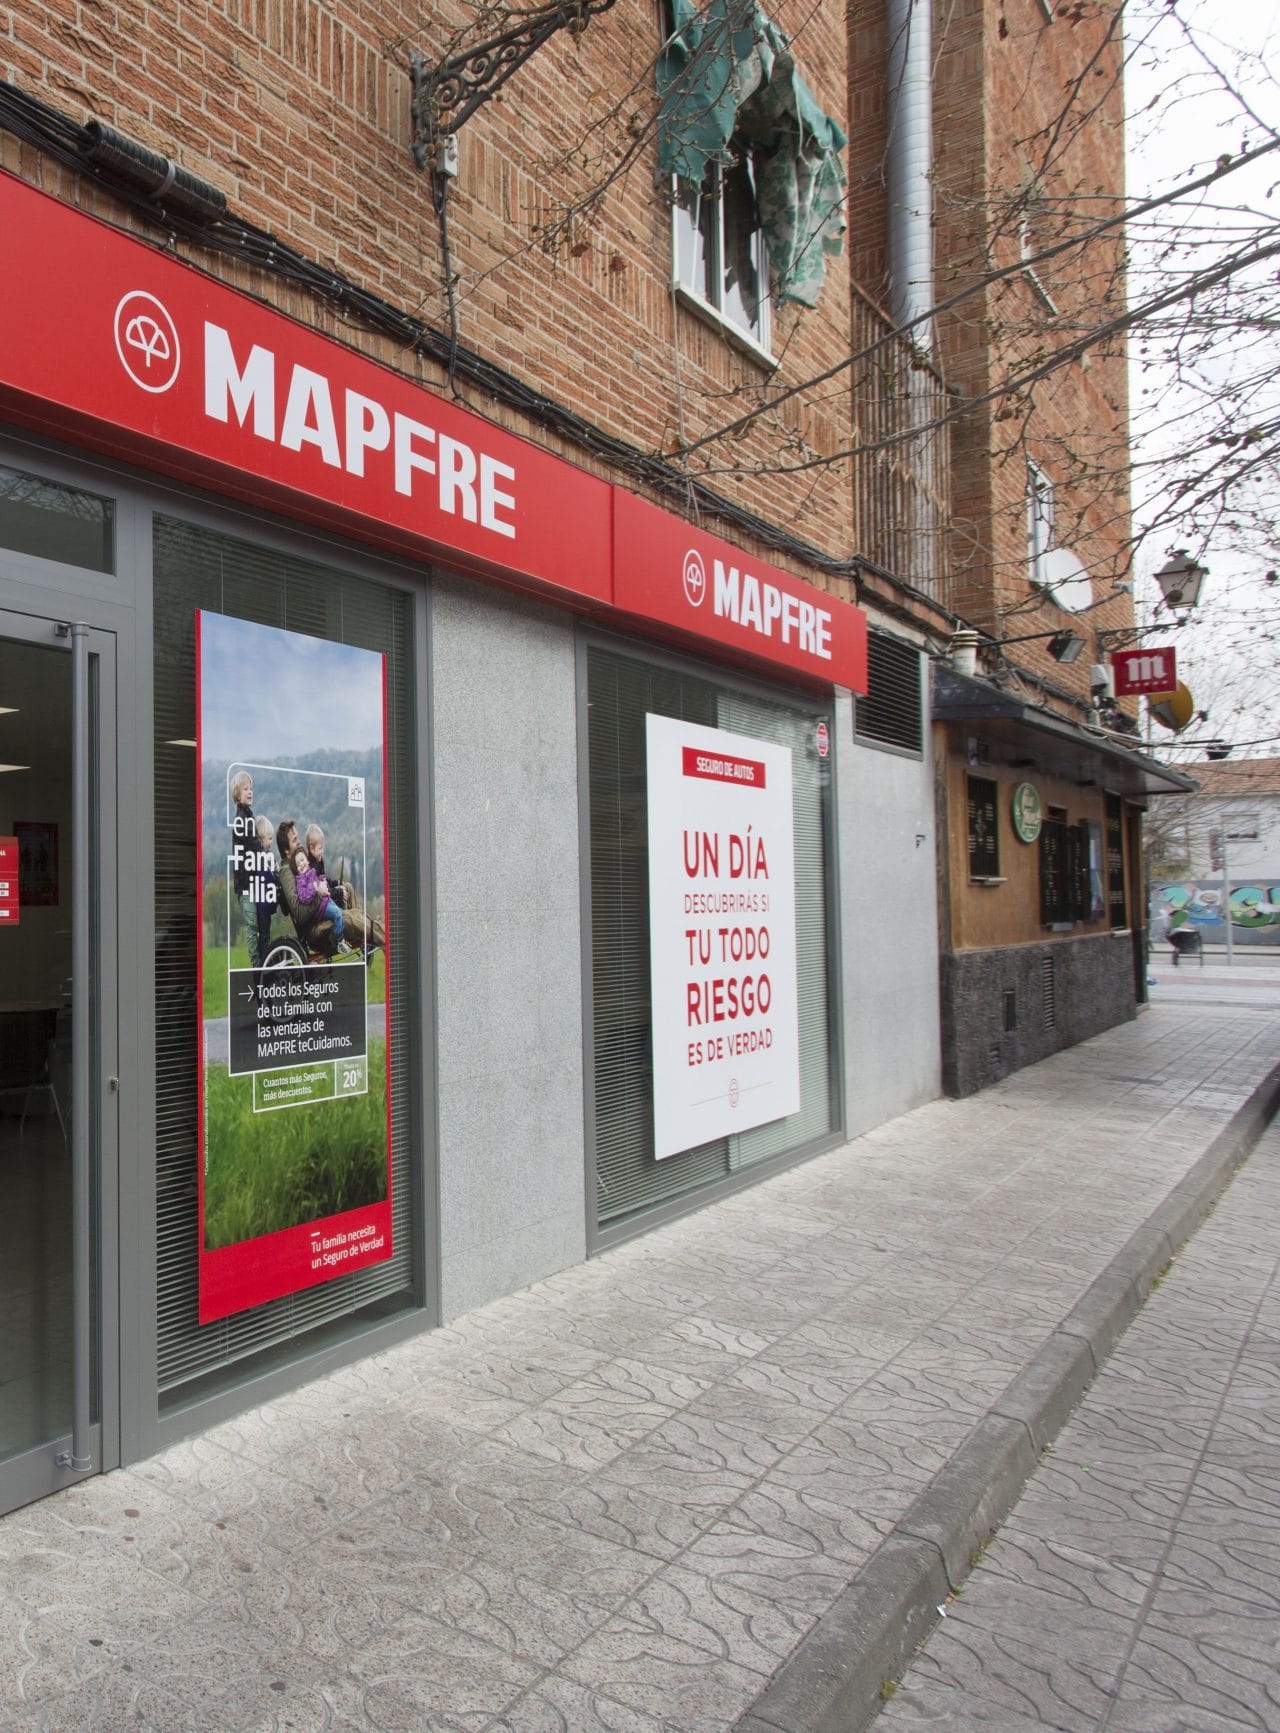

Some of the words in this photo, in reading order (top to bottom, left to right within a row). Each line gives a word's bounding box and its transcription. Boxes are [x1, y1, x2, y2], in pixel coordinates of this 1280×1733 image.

[204, 320, 515, 539] MAPFRE
[713, 559, 832, 660] MAPFRE
[696, 756, 723, 776] SEGURO
[723, 761, 733, 777] DE
[734, 763, 754, 781] AUTOS
[233, 816, 256, 837] en
[233, 844, 275, 872] Fam
[683, 830, 719, 878] UN
[728, 824, 769, 879] DÍA
[684, 890, 758, 914] DESCUBRIRÁS
[761, 894, 770, 913] SI
[685, 929, 711, 966] TU
[718, 926, 770, 962] TODO
[257, 984, 286, 999] Todos
[288, 982, 302, 997] los
[303, 981, 339, 998] Seguros
[687, 973, 771, 1027] RIESGO
[257, 1004, 270, 1019] de
[272, 1004, 282, 1017] tu
[284, 1001, 314, 1016] familia
[316, 1000, 332, 1013] con
[257, 1023, 271, 1038] las
[272, 1019, 311, 1037] ventajas
[313, 1018, 325, 1032] de
[257, 1040, 297, 1058] MAPFRE
[298, 1034, 352, 1051] teCuidamos.
[688, 1041, 703, 1067] ES
[707, 1037, 723, 1062] DE
[726, 1027, 773, 1056] VERDAD
[263, 1076, 289, 1088] Cuantos
[289, 1074, 303, 1083] más
[263, 1091, 277, 1102] más
[311, 1241, 321, 1253] Tu
[322, 1233, 347, 1250] familia
[347, 1225, 376, 1242] necesita
[311, 1258, 322, 1269] un
[323, 1249, 348, 1266] Seguro
[349, 1244, 359, 1257] de
[359, 1235, 384, 1253] Verdad
